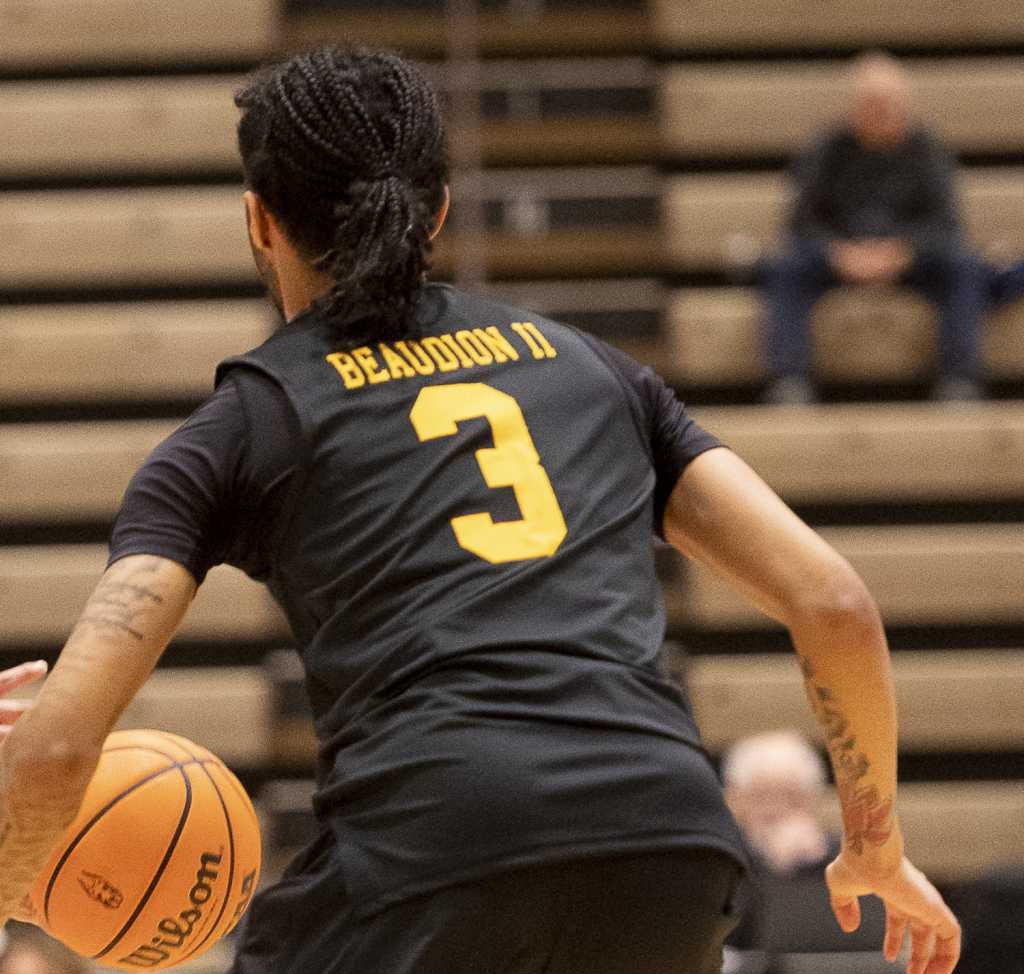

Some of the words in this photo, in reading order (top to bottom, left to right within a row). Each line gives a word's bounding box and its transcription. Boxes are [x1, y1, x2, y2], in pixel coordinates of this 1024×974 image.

[326, 326, 520, 390] BEAUDION
[511, 322, 558, 360] II
[409, 382, 568, 564] 3
[119, 851, 223, 968] Wilson
